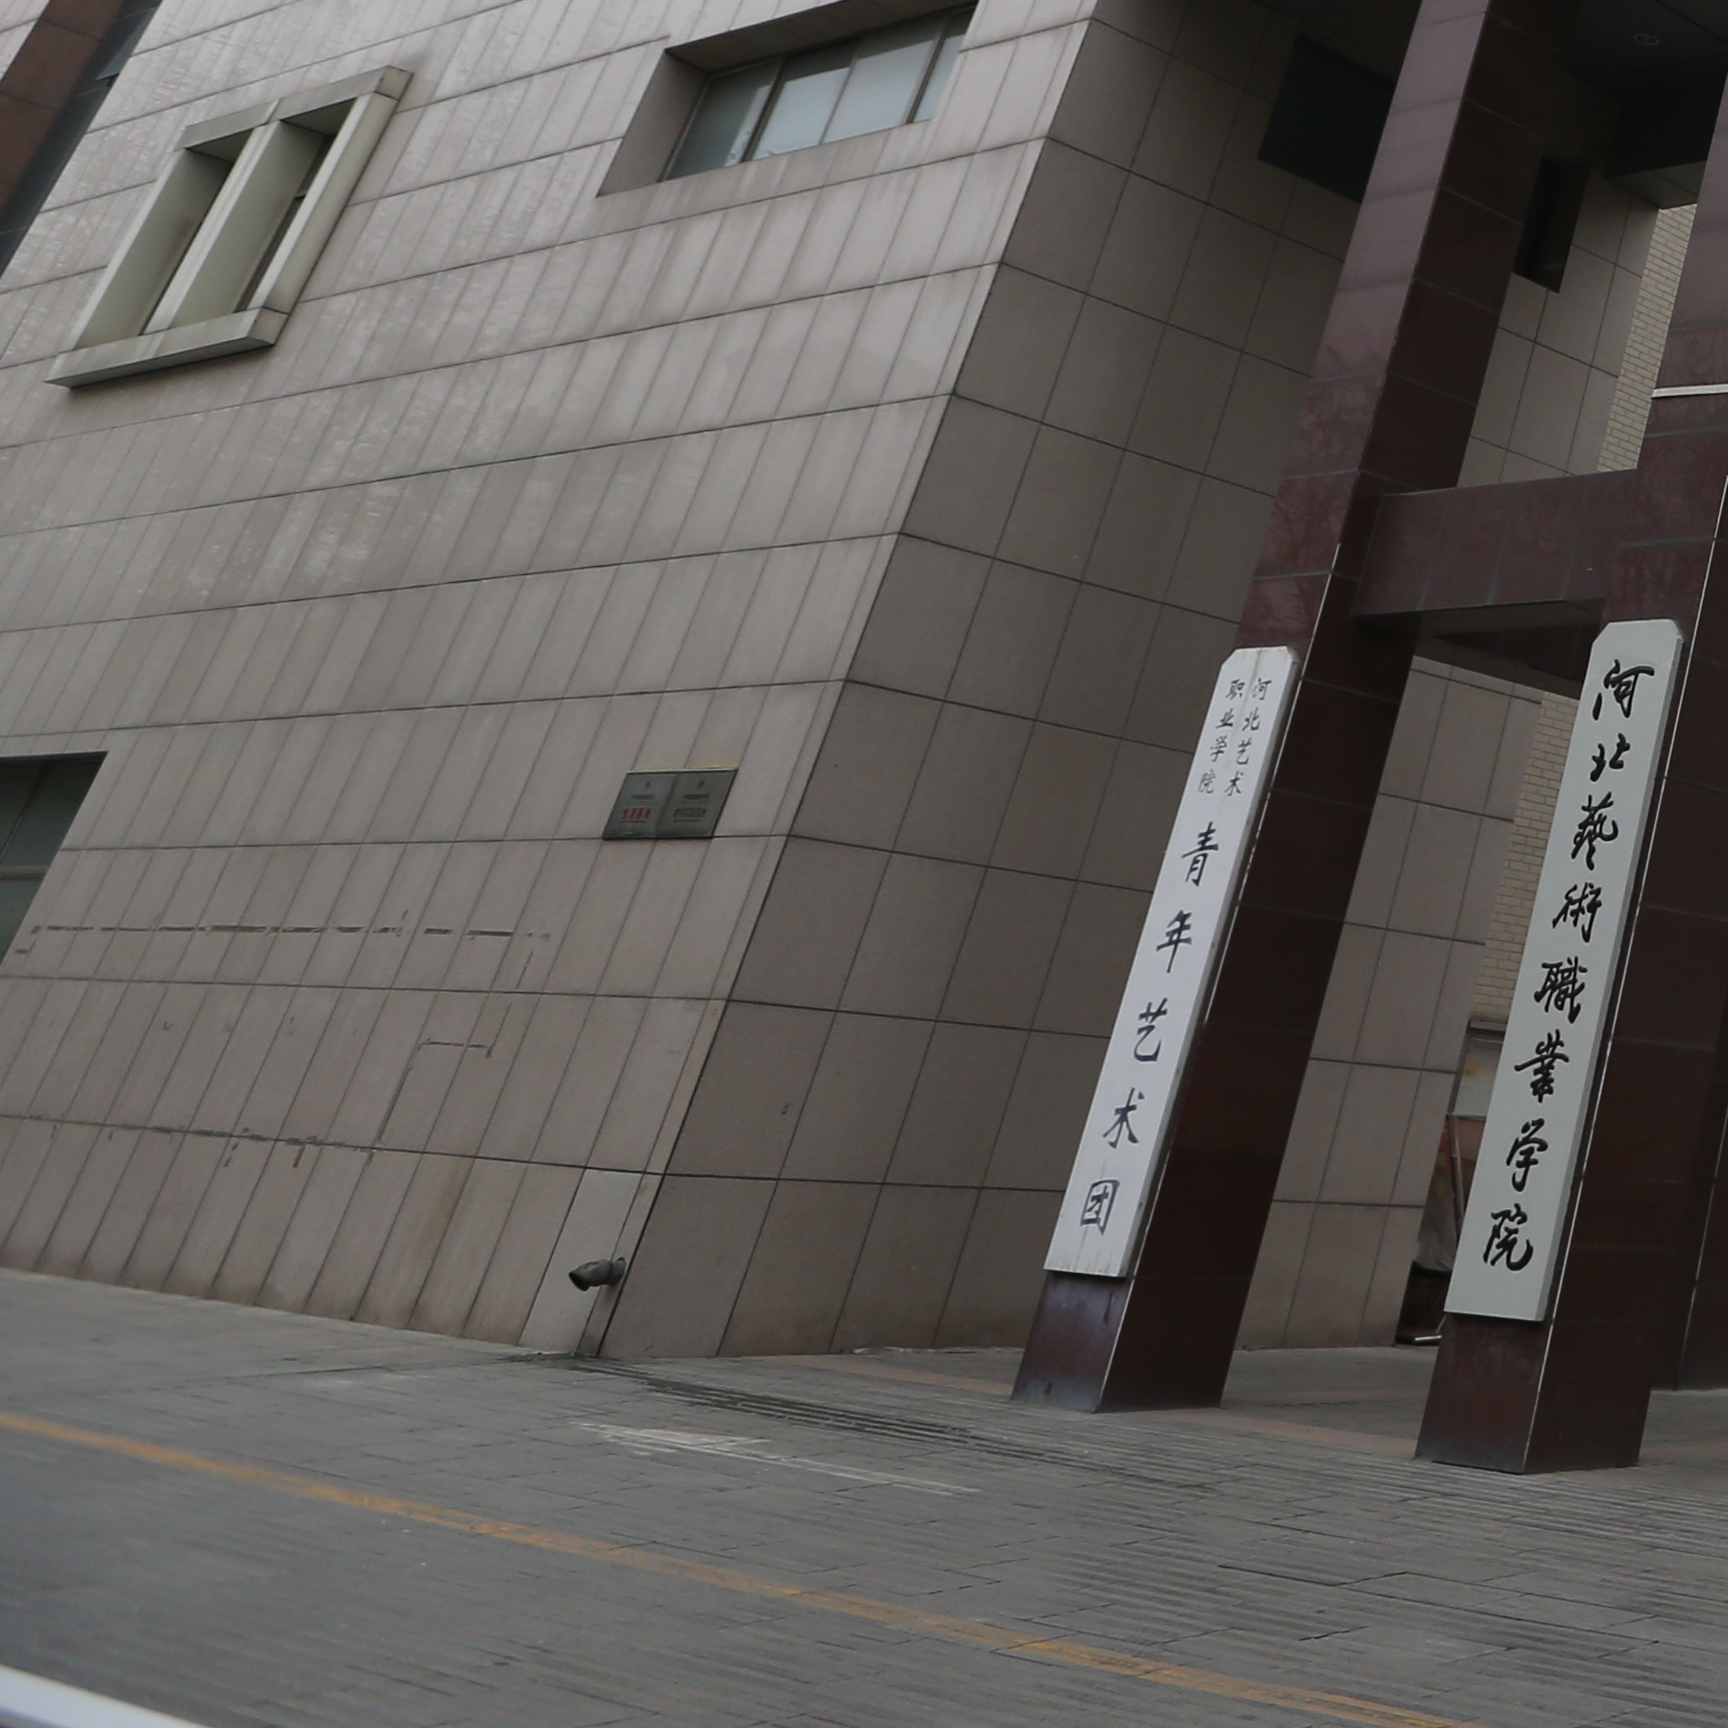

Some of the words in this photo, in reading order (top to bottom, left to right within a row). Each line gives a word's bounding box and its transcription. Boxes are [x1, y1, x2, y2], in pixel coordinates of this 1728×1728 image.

[1081, 821, 1219, 1235] 青年艺术团
